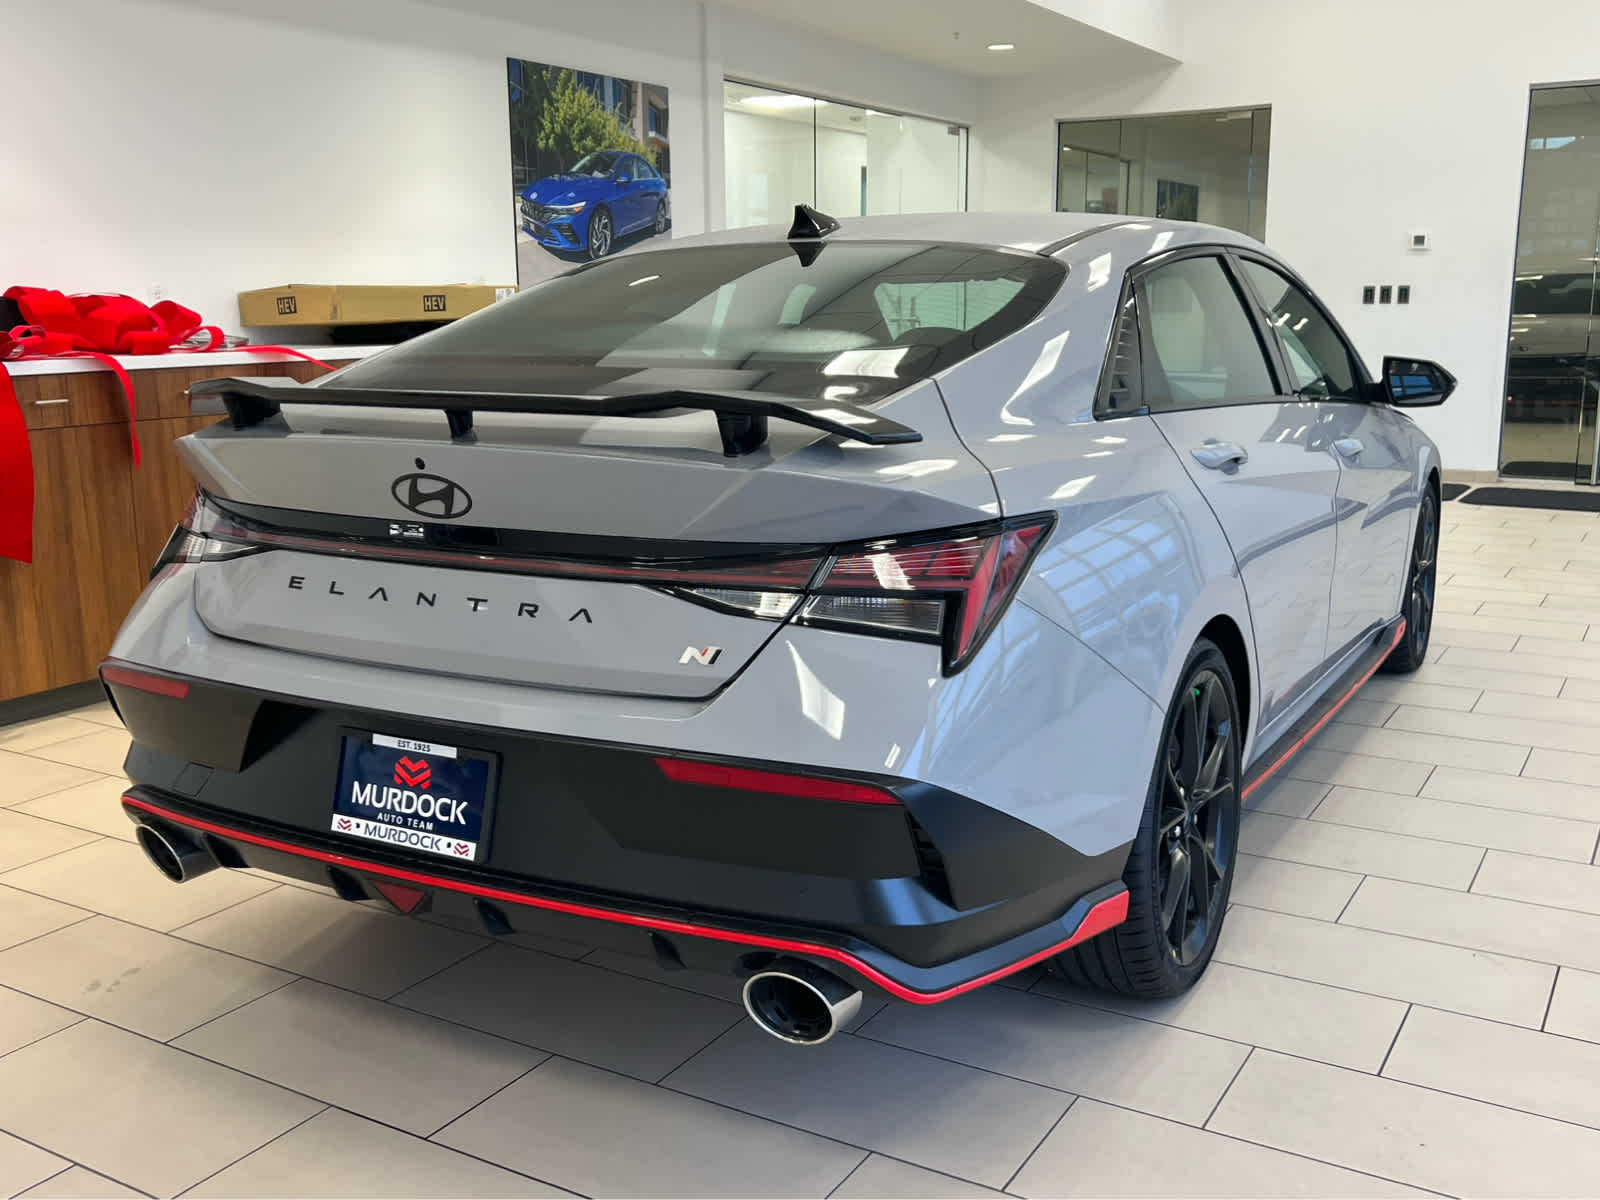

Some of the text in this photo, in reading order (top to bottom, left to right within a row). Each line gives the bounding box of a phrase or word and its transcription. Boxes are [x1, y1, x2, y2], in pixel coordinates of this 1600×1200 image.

[278, 298, 296, 313] HEV
[424, 296, 445, 311] HEV
[288, 575, 593, 623] ELANTRA
[413, 742, 431, 752] 1925
[351, 780, 468, 825] MURDOCK
[377, 812, 434, 831] AUTO TEAM
[364, 822, 442, 851] MURDOCK
